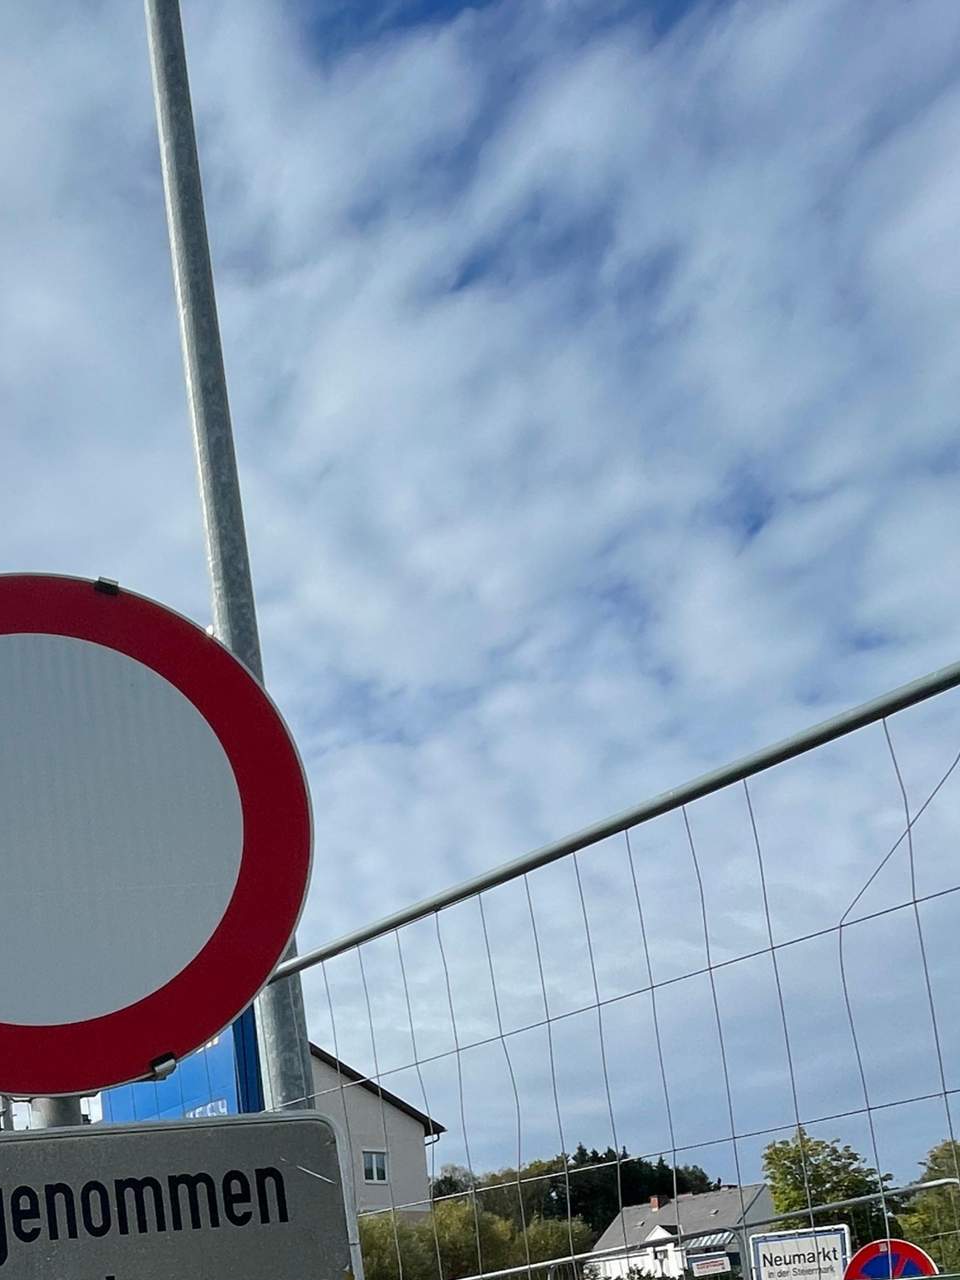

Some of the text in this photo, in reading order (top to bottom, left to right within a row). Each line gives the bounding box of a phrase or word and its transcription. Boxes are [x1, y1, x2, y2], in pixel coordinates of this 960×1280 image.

[762, 1246, 839, 1268] Neumarkt
[768, 1265, 835, 1279] in der Steiermark
